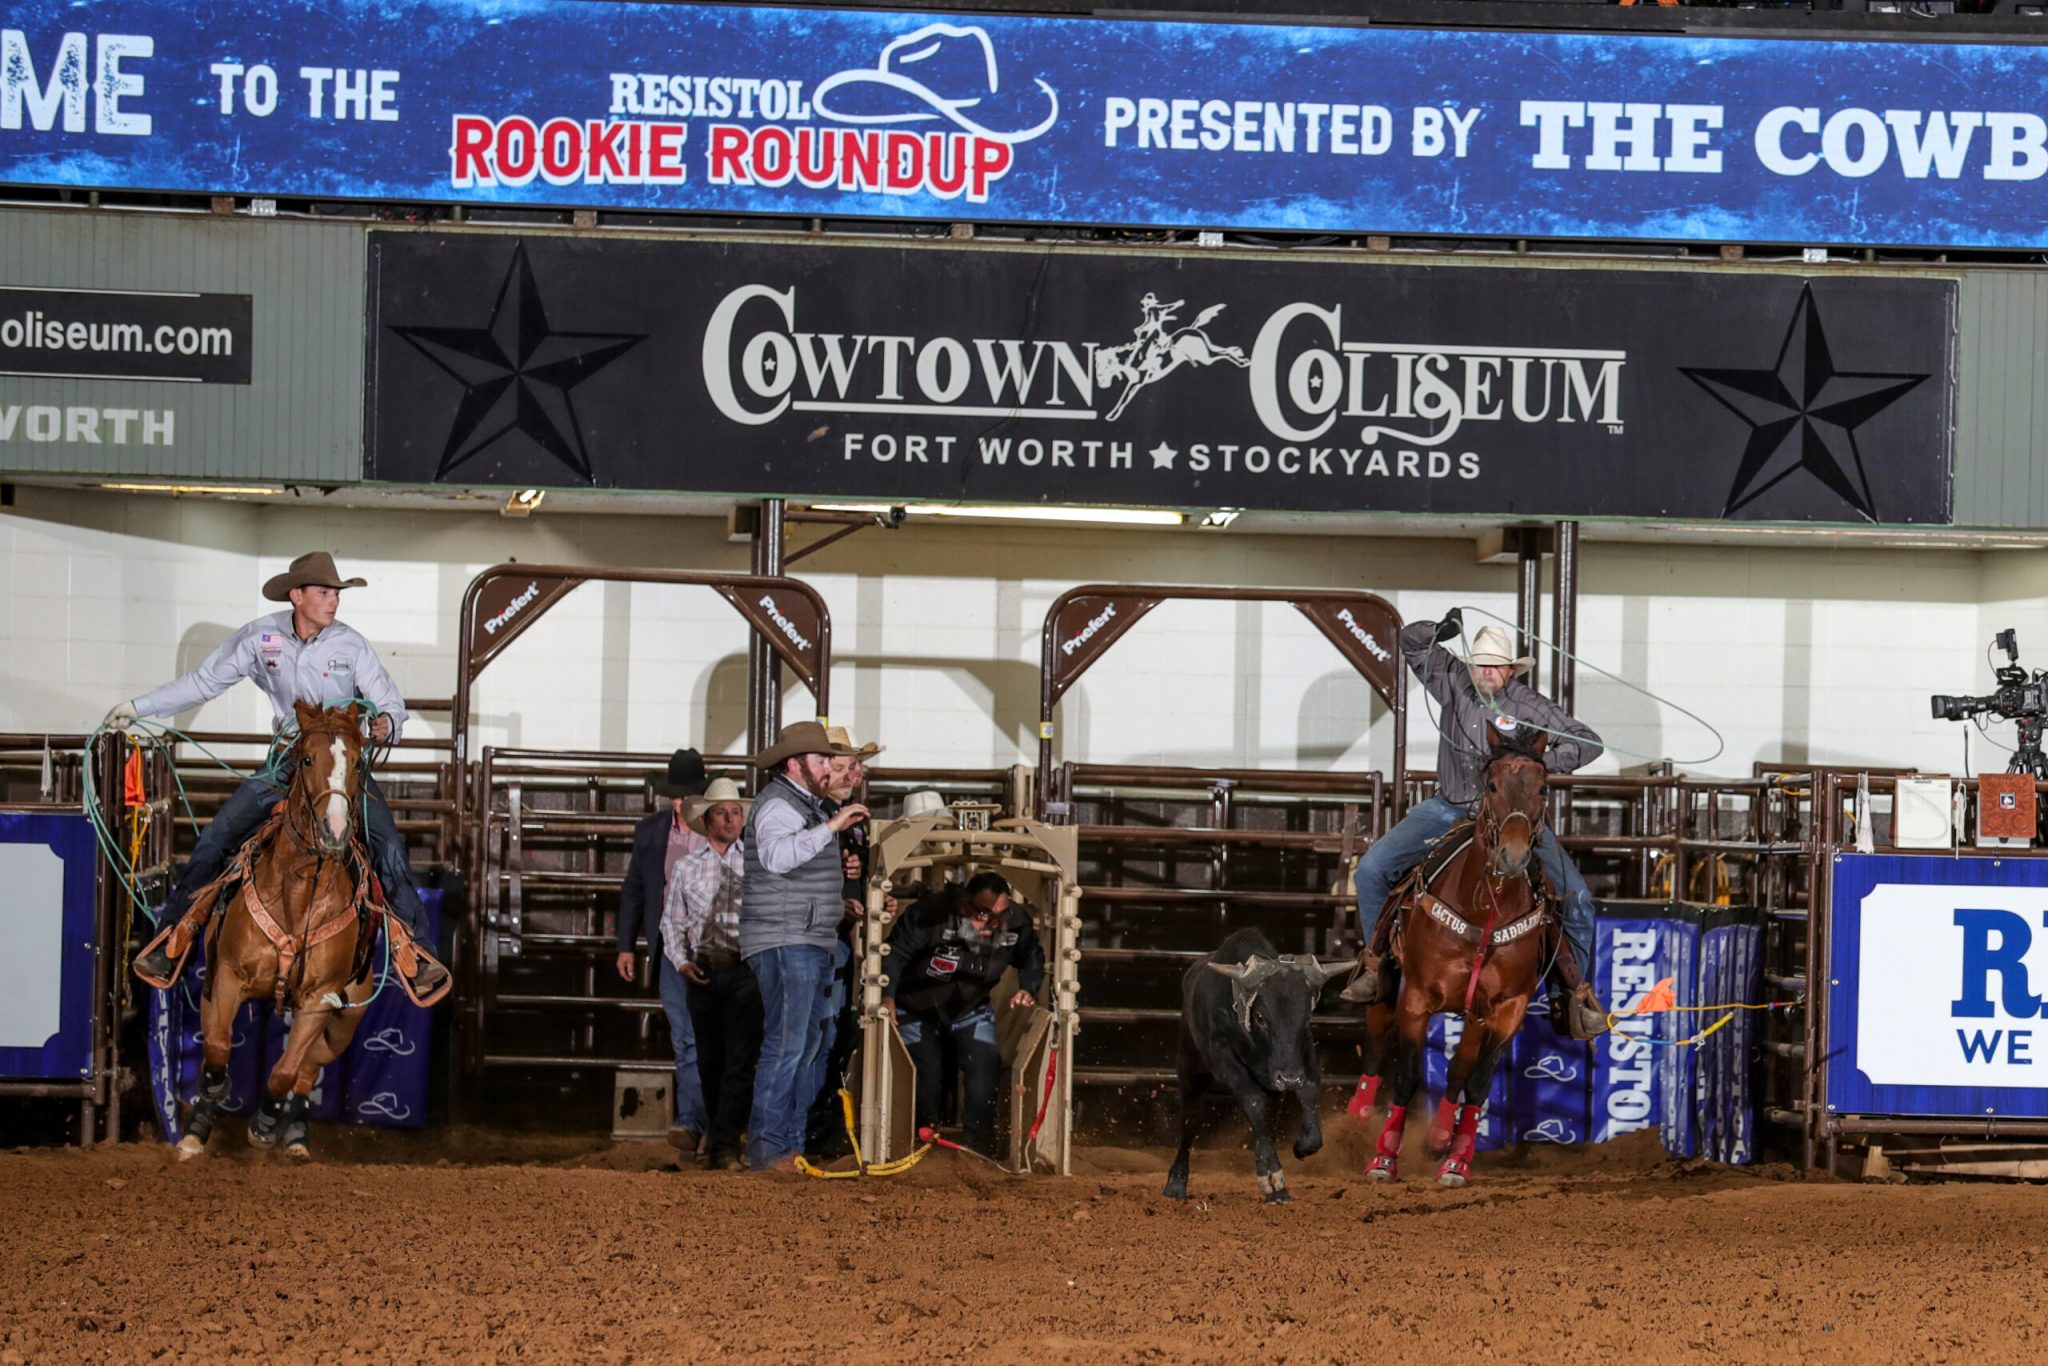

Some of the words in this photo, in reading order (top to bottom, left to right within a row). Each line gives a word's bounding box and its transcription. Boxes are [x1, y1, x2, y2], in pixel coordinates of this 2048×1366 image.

[210, 63, 279, 117] TO
[300, 67, 400, 121] THE
[609, 73, 811, 120] RESISTOL
[452, 116, 687, 187] ROOKIE
[706, 124, 1013, 203] ROUNDUP
[1104, 97, 1393, 155] PRESENTED
[1412, 106, 1481, 157] BY
[1520, 100, 1724, 173] THE
[1754, 106, 2048, 180] COWB
[1, 311, 232, 356] oliseum.com
[702, 284, 1100, 425] COWTOWN
[1249, 302, 1626, 446] COLISEUM
[844, 433, 957, 463] FORT
[978, 437, 1132, 469] WORTH
[1189, 443, 1480, 479] STOCKYARDS
[1431, 902, 1467, 934] CACTUS
[1956, 1029, 2032, 1065] WE
